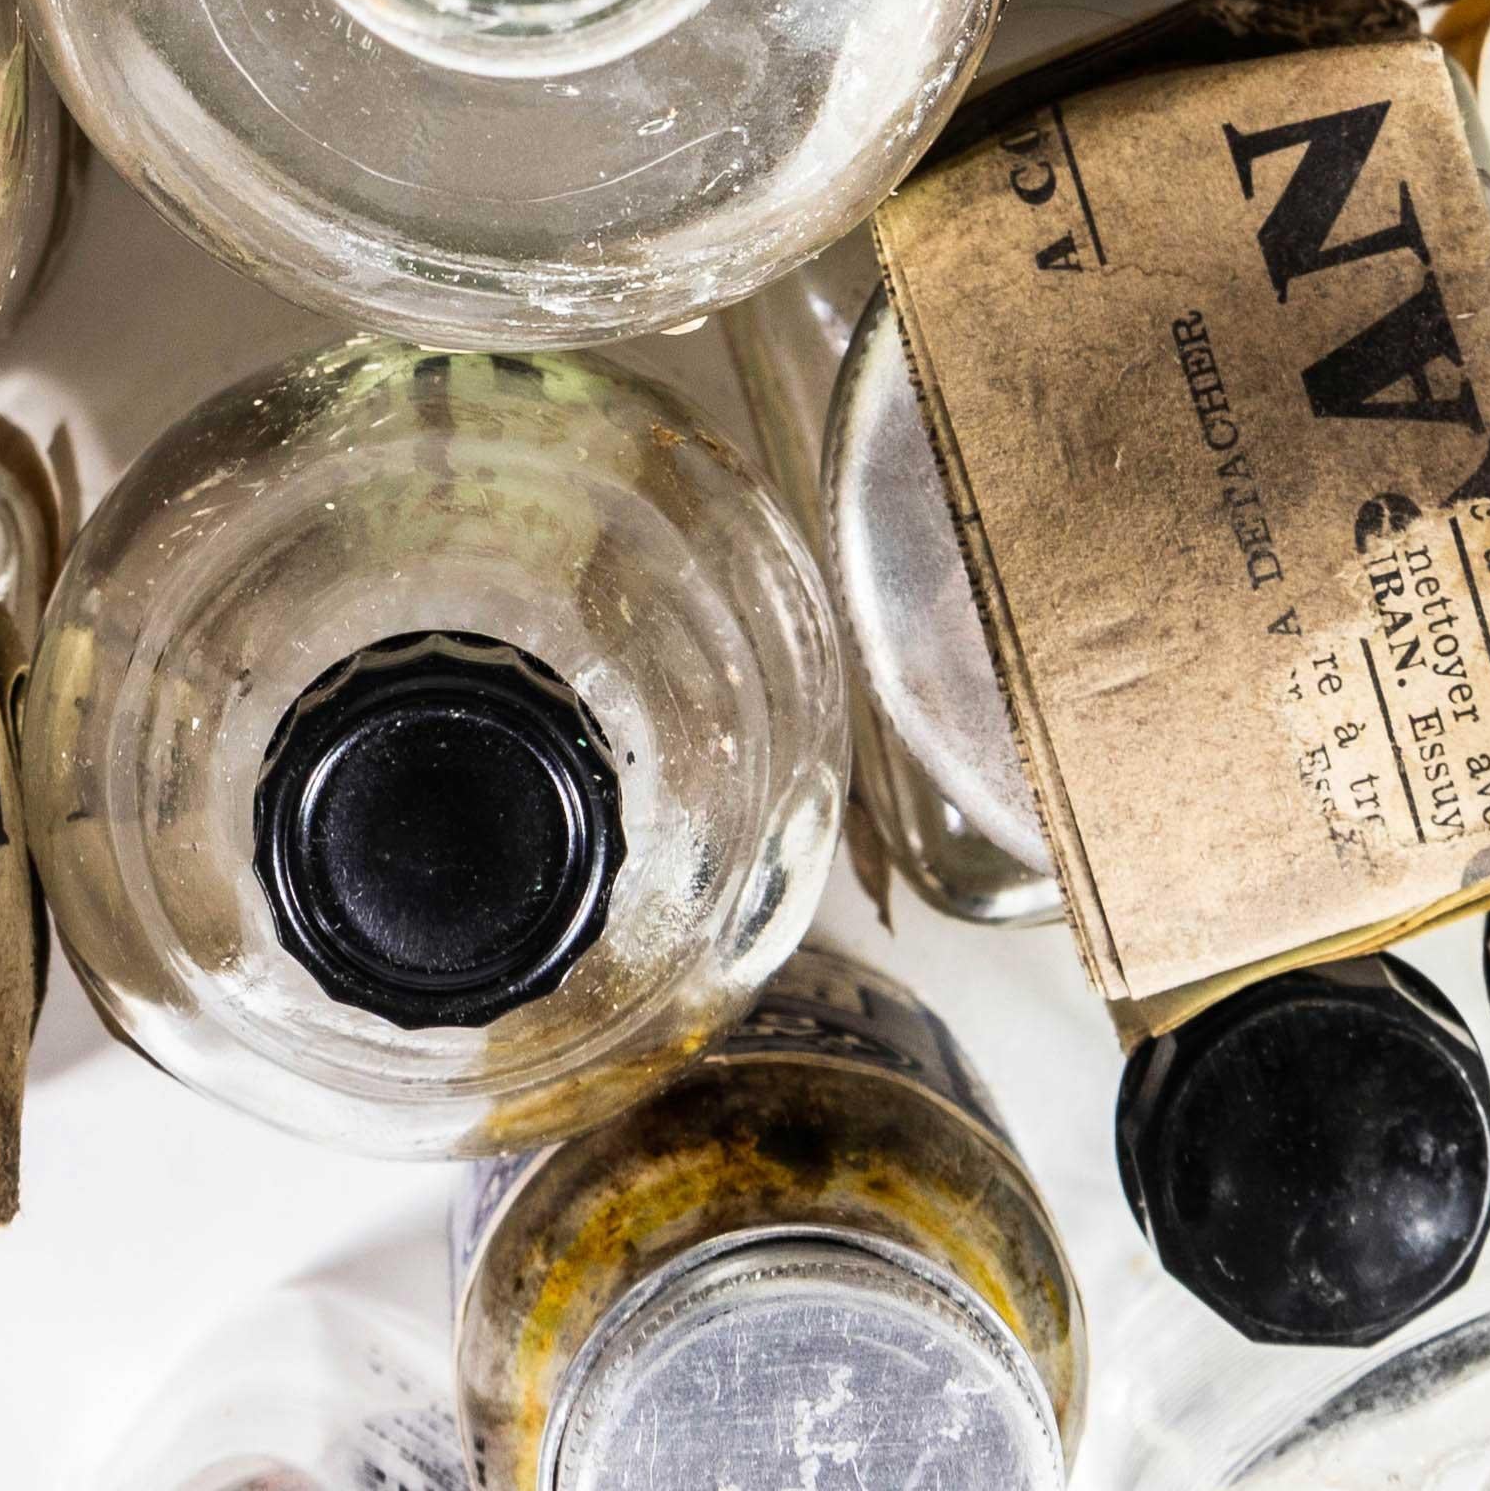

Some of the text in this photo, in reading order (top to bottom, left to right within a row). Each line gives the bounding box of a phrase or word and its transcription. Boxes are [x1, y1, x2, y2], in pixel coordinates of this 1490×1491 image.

[1033, 233, 1083, 274] A
[1170, 308, 1301, 638] A DETACHER
[1405, 544, 1482, 725] nettoyer
[1333, 718, 1362, 748] à
